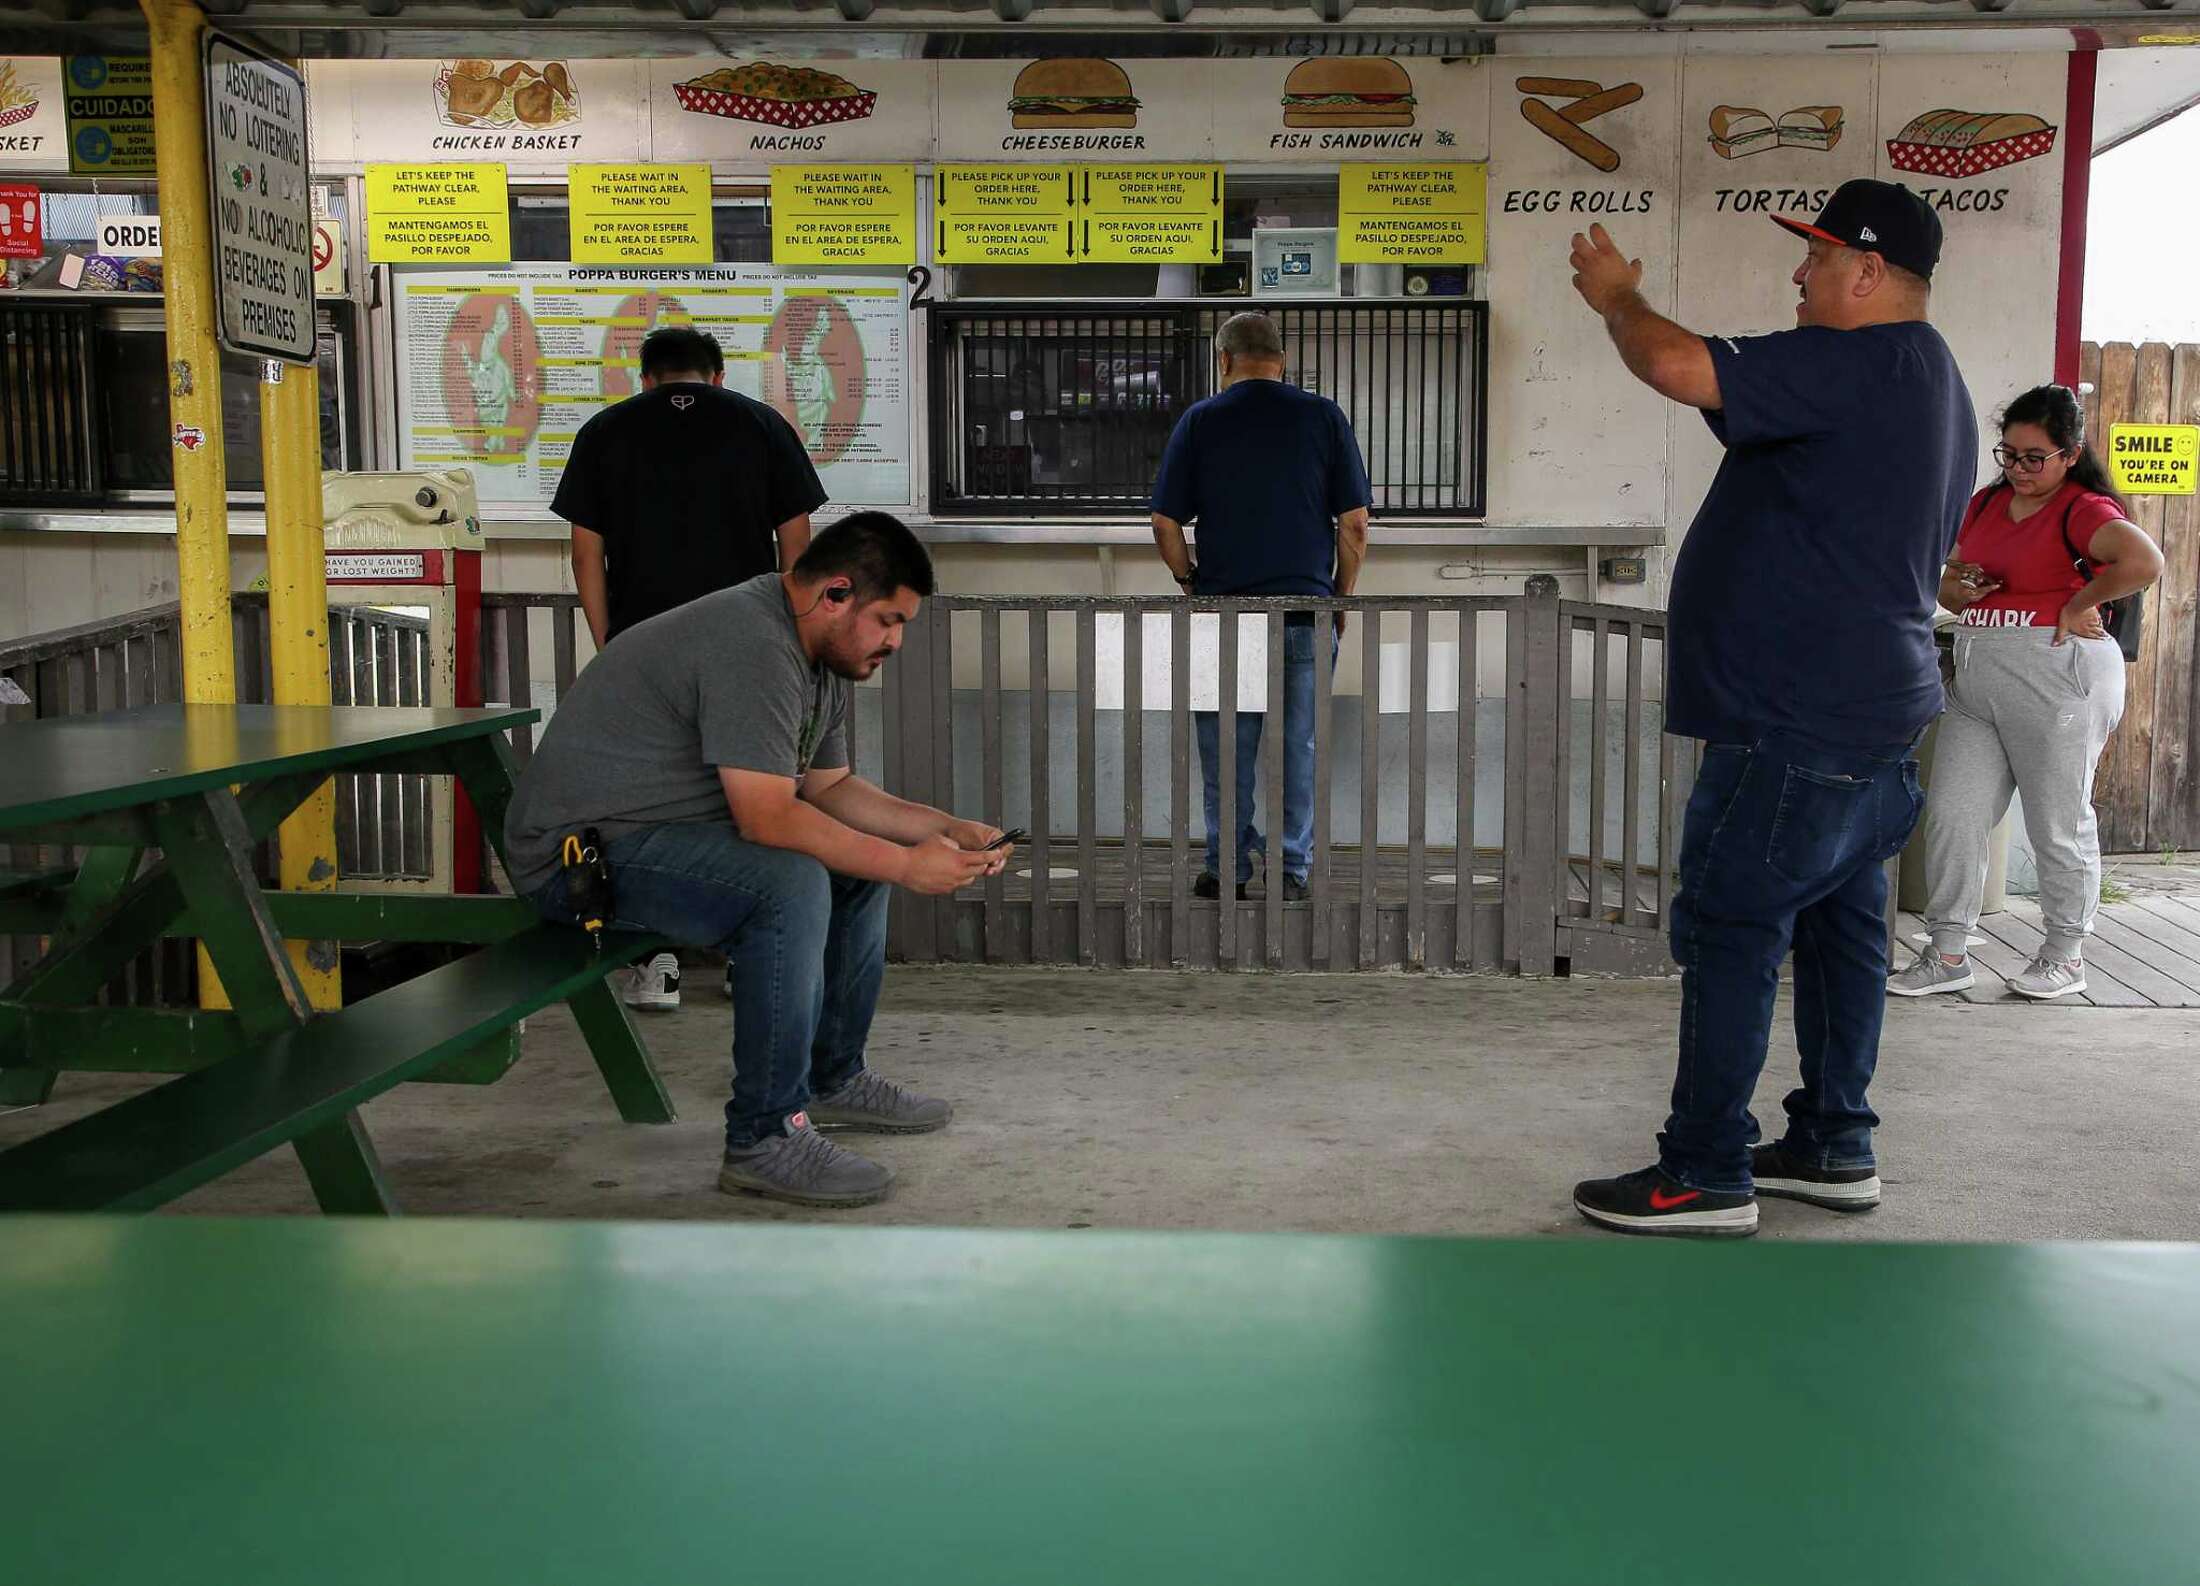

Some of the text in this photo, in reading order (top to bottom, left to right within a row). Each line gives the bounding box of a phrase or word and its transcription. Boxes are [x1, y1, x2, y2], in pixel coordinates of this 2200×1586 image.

[225, 60, 291, 120] ABSOLUTELY
[219, 102, 299, 166] NO LOITERING
[432, 135, 581, 150] CHICKEN BASKET
[750, 136, 826, 151] NACHOS
[1001, 135, 1146, 151] CHEESEBURGER
[1270, 134, 1313, 150] FISH
[1319, 133, 1423, 150] SANDWICH
[260, 162, 268, 197] &
[396, 171, 475, 180] LET'S KEEP THE
[601, 173, 679, 181] PLEASE WAIT IN
[804, 173, 882, 182] PLEASE WAIT IN
[952, 172, 1061, 181] PLEASE PICK UP YOUR
[1096, 172, 1206, 180] PLEASE PICK UP YOUR
[1372, 171, 1454, 180] LET'S KEEP THE
[393, 184, 480, 194] PATHWAY CLEAR,
[592, 185, 689, 194] THE WAITING AREA,
[794, 185, 892, 194] THE WAITING AREA,
[974, 184, 1040, 194] ORDER HERE,
[1119, 184, 1185, 193] ORDER HERE,
[1367, 184, 1457, 194] PATHWAY CLEAR,
[418, 197, 456, 205] PLEASE
[611, 197, 670, 206] THANK YOU
[813, 198, 873, 206] THANK YOU
[977, 197, 1037, 205] THANK YOU
[1122, 196, 1183, 205] THANK YOU
[1393, 197, 1432, 206] PLEASE
[1503, 190, 1653, 213] EGG ROLLS
[1714, 190, 1827, 213] TORTAS
[1920, 188, 2009, 212] TACOS
[221, 196, 306, 255] NO ALCOHOLIC
[388, 221, 489, 230] MANTENGAMOS EL
[594, 223, 689, 232] POR FAVOR ESPERE
[796, 224, 891, 232] POR FAVOR ESPERE
[955, 223, 1058, 232] POR FAVOR LEVANTE
[1099, 223, 1203, 231] POR FAVOR LEVANTE
[1360, 221, 1463, 230] MANTENGAMOS EL
[385, 233, 493, 244] PASILLO DESPEJADO,
[584, 236, 699, 245] EN EL AREA DE ESPERA,
[786, 236, 901, 245] EN EL AREA DE ESPERA,
[967, 236, 1049, 245] SU ORDEN AQUI,
[1111, 235, 1193, 244] SU ORDEN AQUI,
[1356, 234, 1467, 244] PASILLO DESPEJADO,
[412, 246, 471, 255] POR FAVOR
[621, 247, 664, 256] GRACIAS
[823, 248, 866, 257] GRACIAS
[986, 247, 1030, 256] GRACIAS
[1130, 247, 1174, 255] GRACIAS
[1383, 247, 1443, 255] POR FAVOR
[224, 246, 308, 300] BEVERAGES ON
[569, 269, 736, 281] POPPA BURGER'S MENU
[908, 266, 934, 310] 2
[242, 299, 297, 343] PREMISES
[2115, 435, 2173, 453] SMILE
[2120, 459, 2189, 471] YOU'RE ON
[2127, 473, 2178, 484] CAMERA
[326, 558, 416, 566] HAVE YOU GAINED
[326, 567, 339, 575] OR
[344, 567, 367, 575] LOST
